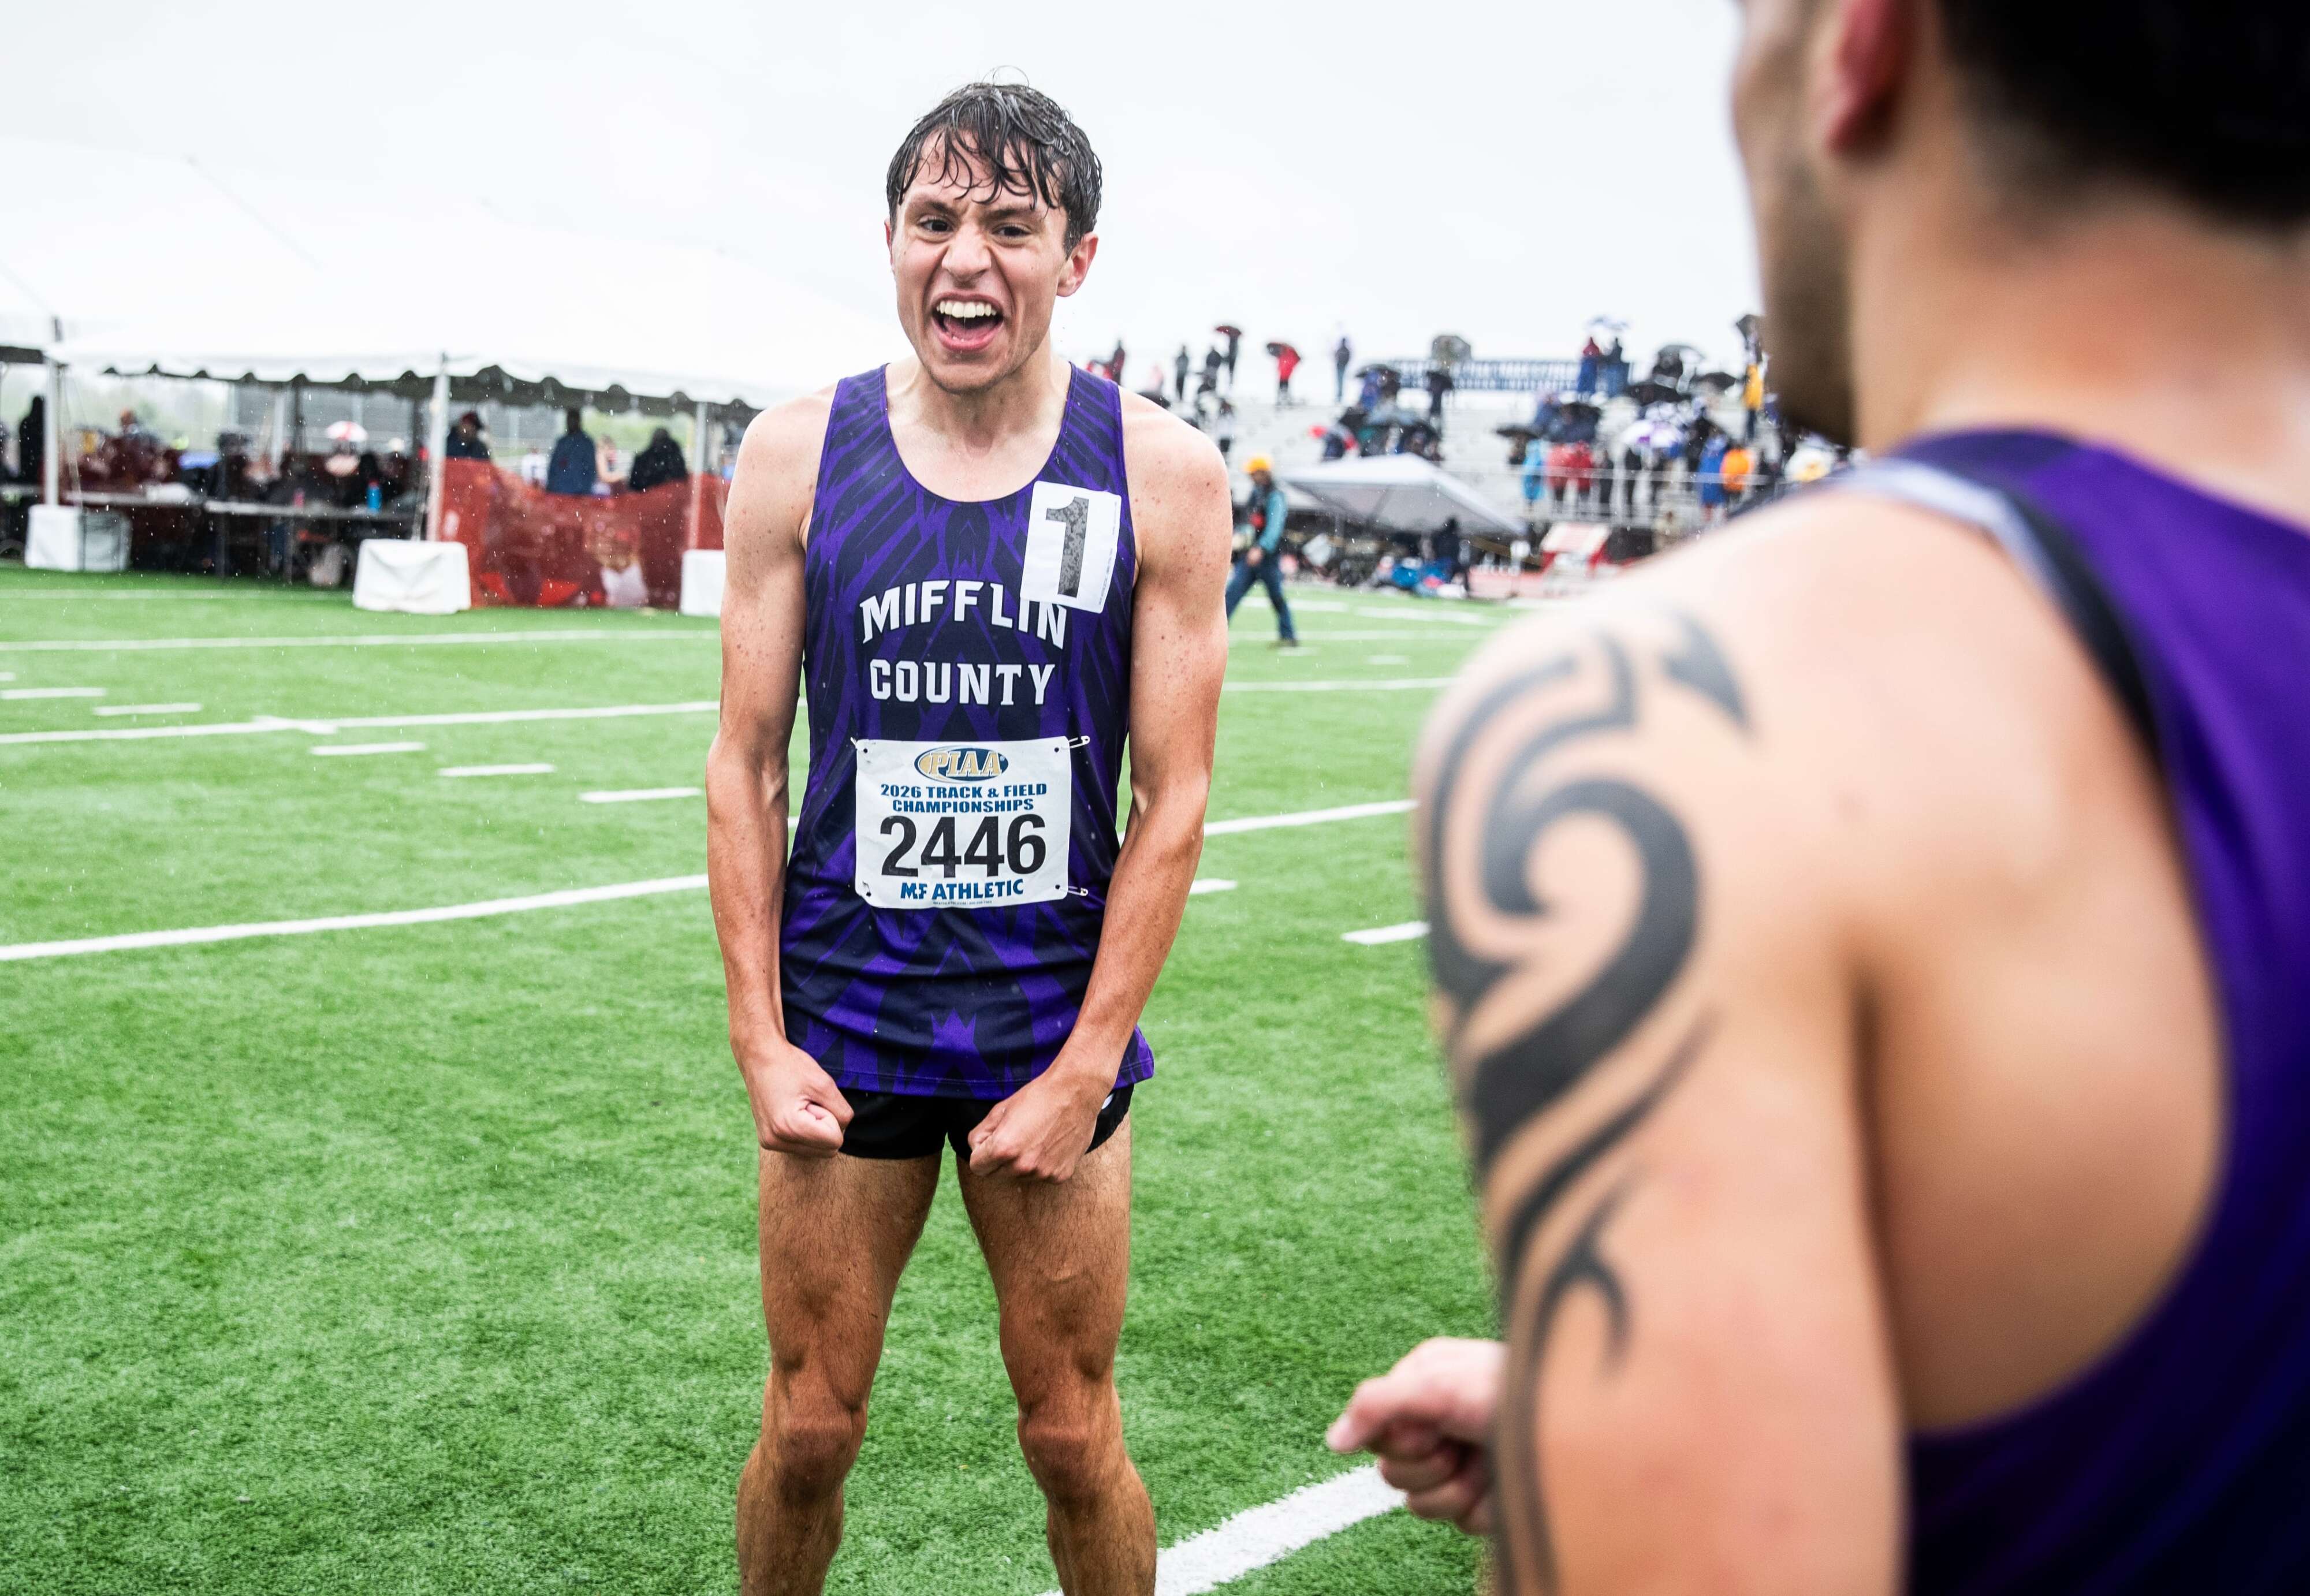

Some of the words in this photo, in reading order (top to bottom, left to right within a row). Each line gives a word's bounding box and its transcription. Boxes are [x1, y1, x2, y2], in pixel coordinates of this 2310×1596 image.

[1046, 497, 1089, 598] 1
[859, 579, 1067, 650] MIFFLIN
[870, 659, 1055, 705] COUNTY
[929, 750, 1003, 777] PIAA
[881, 784, 922, 798] 2026
[926, 786, 982, 799] TRACK
[987, 788, 999, 798] &
[1004, 783, 1047, 797] FIELD
[893, 798, 1034, 813] CHAMPIONSHIPS
[880, 814, 1046, 878] 2446
[900, 882, 928, 900] MF
[932, 878, 1024, 900] ATHLETIC
